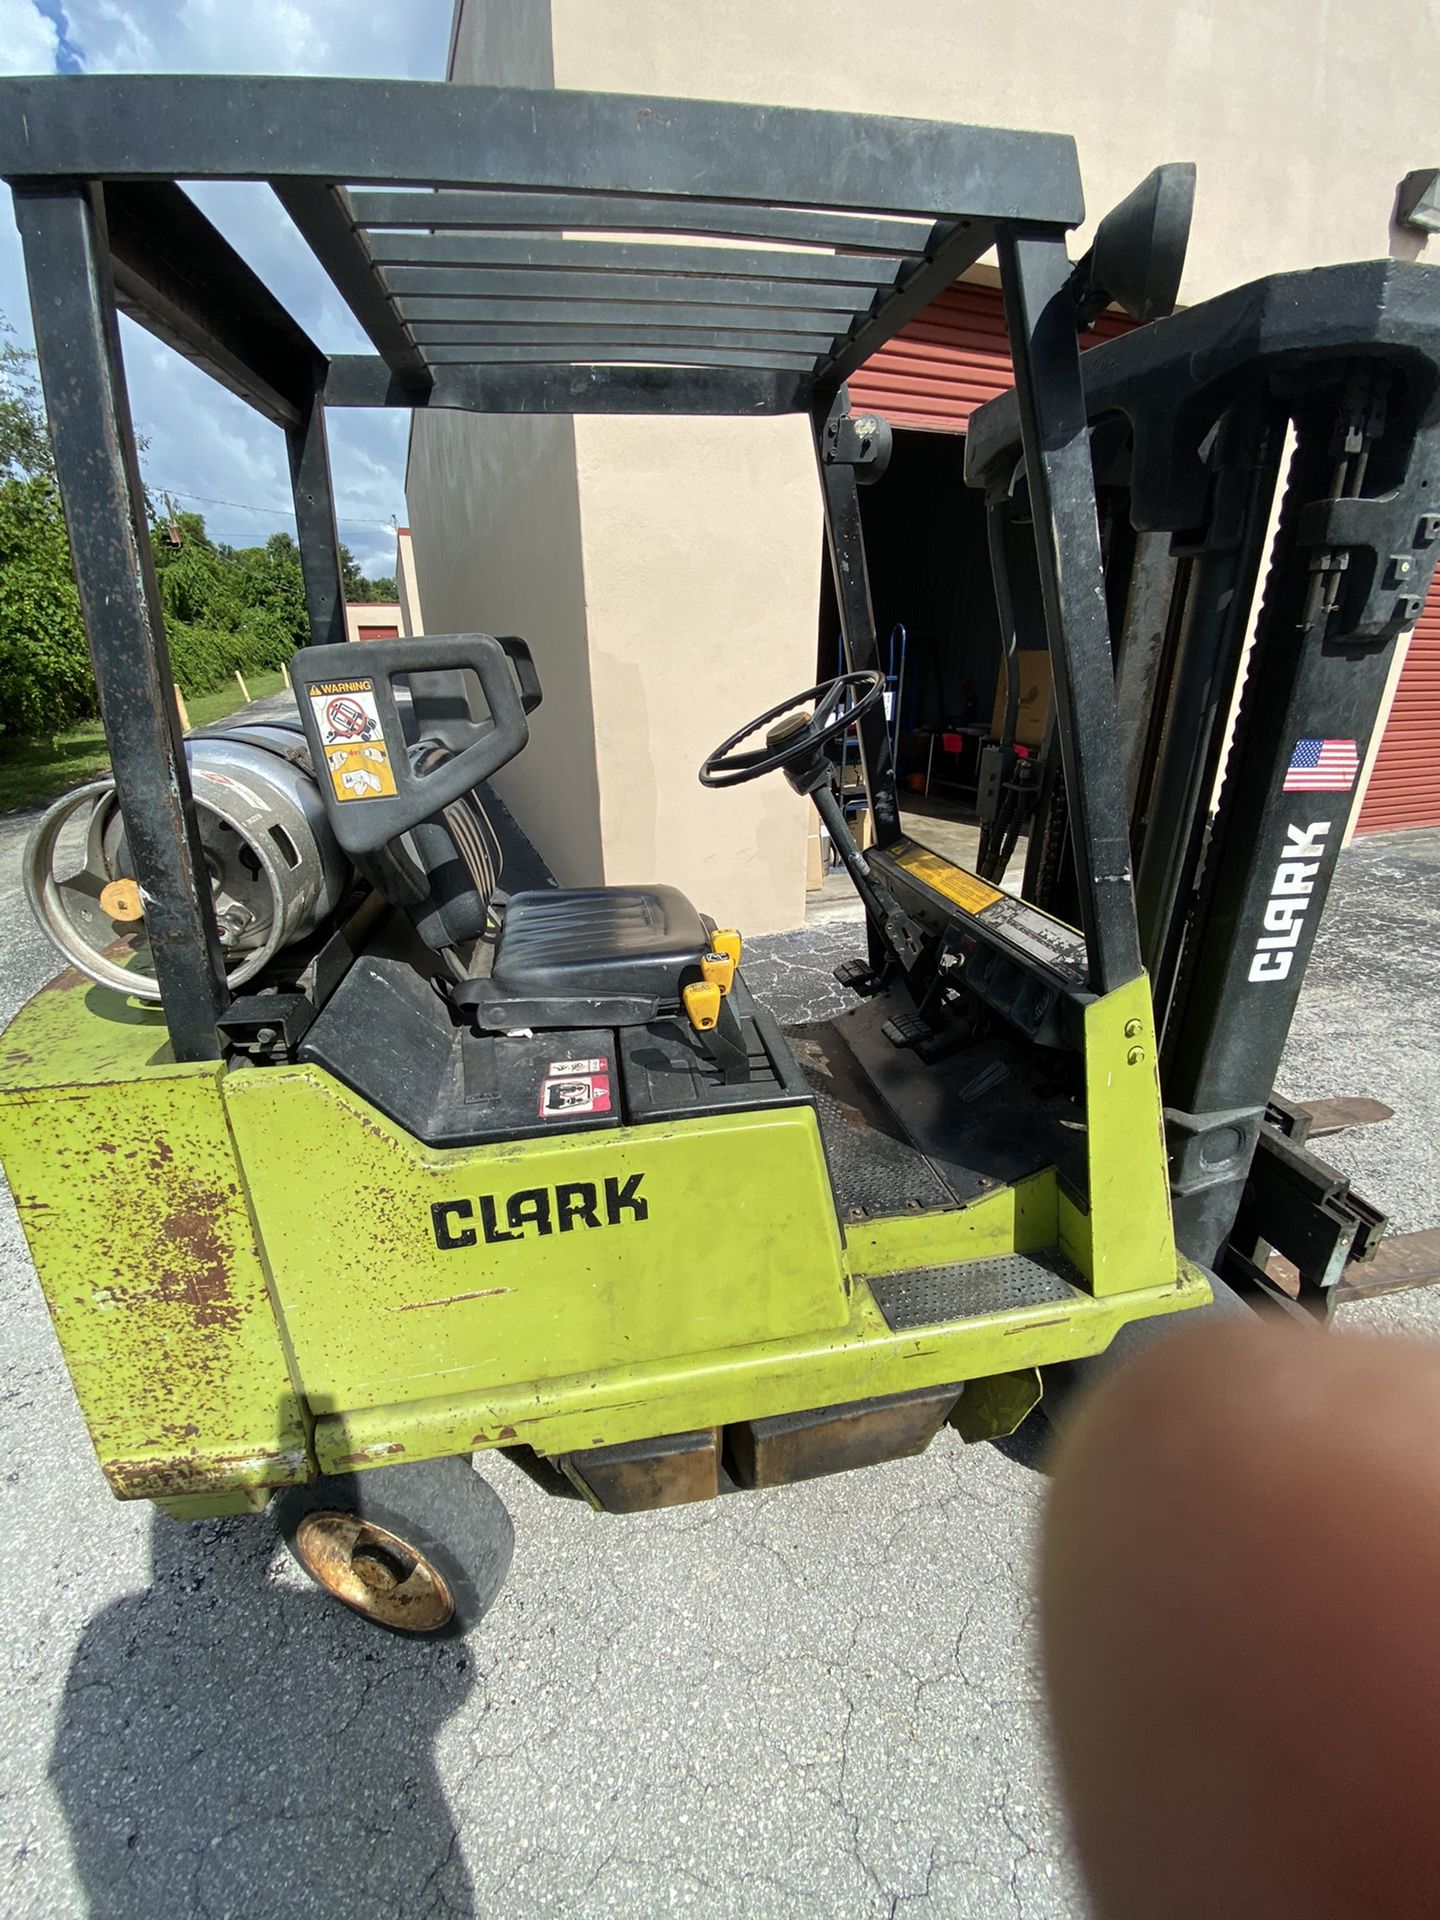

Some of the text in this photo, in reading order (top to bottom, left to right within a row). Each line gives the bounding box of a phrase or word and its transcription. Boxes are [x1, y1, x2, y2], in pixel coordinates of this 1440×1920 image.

[320, 681, 372, 694] WARNING
[1248, 822, 1331, 982] CLARK
[431, 1173, 648, 1250] CLARK
